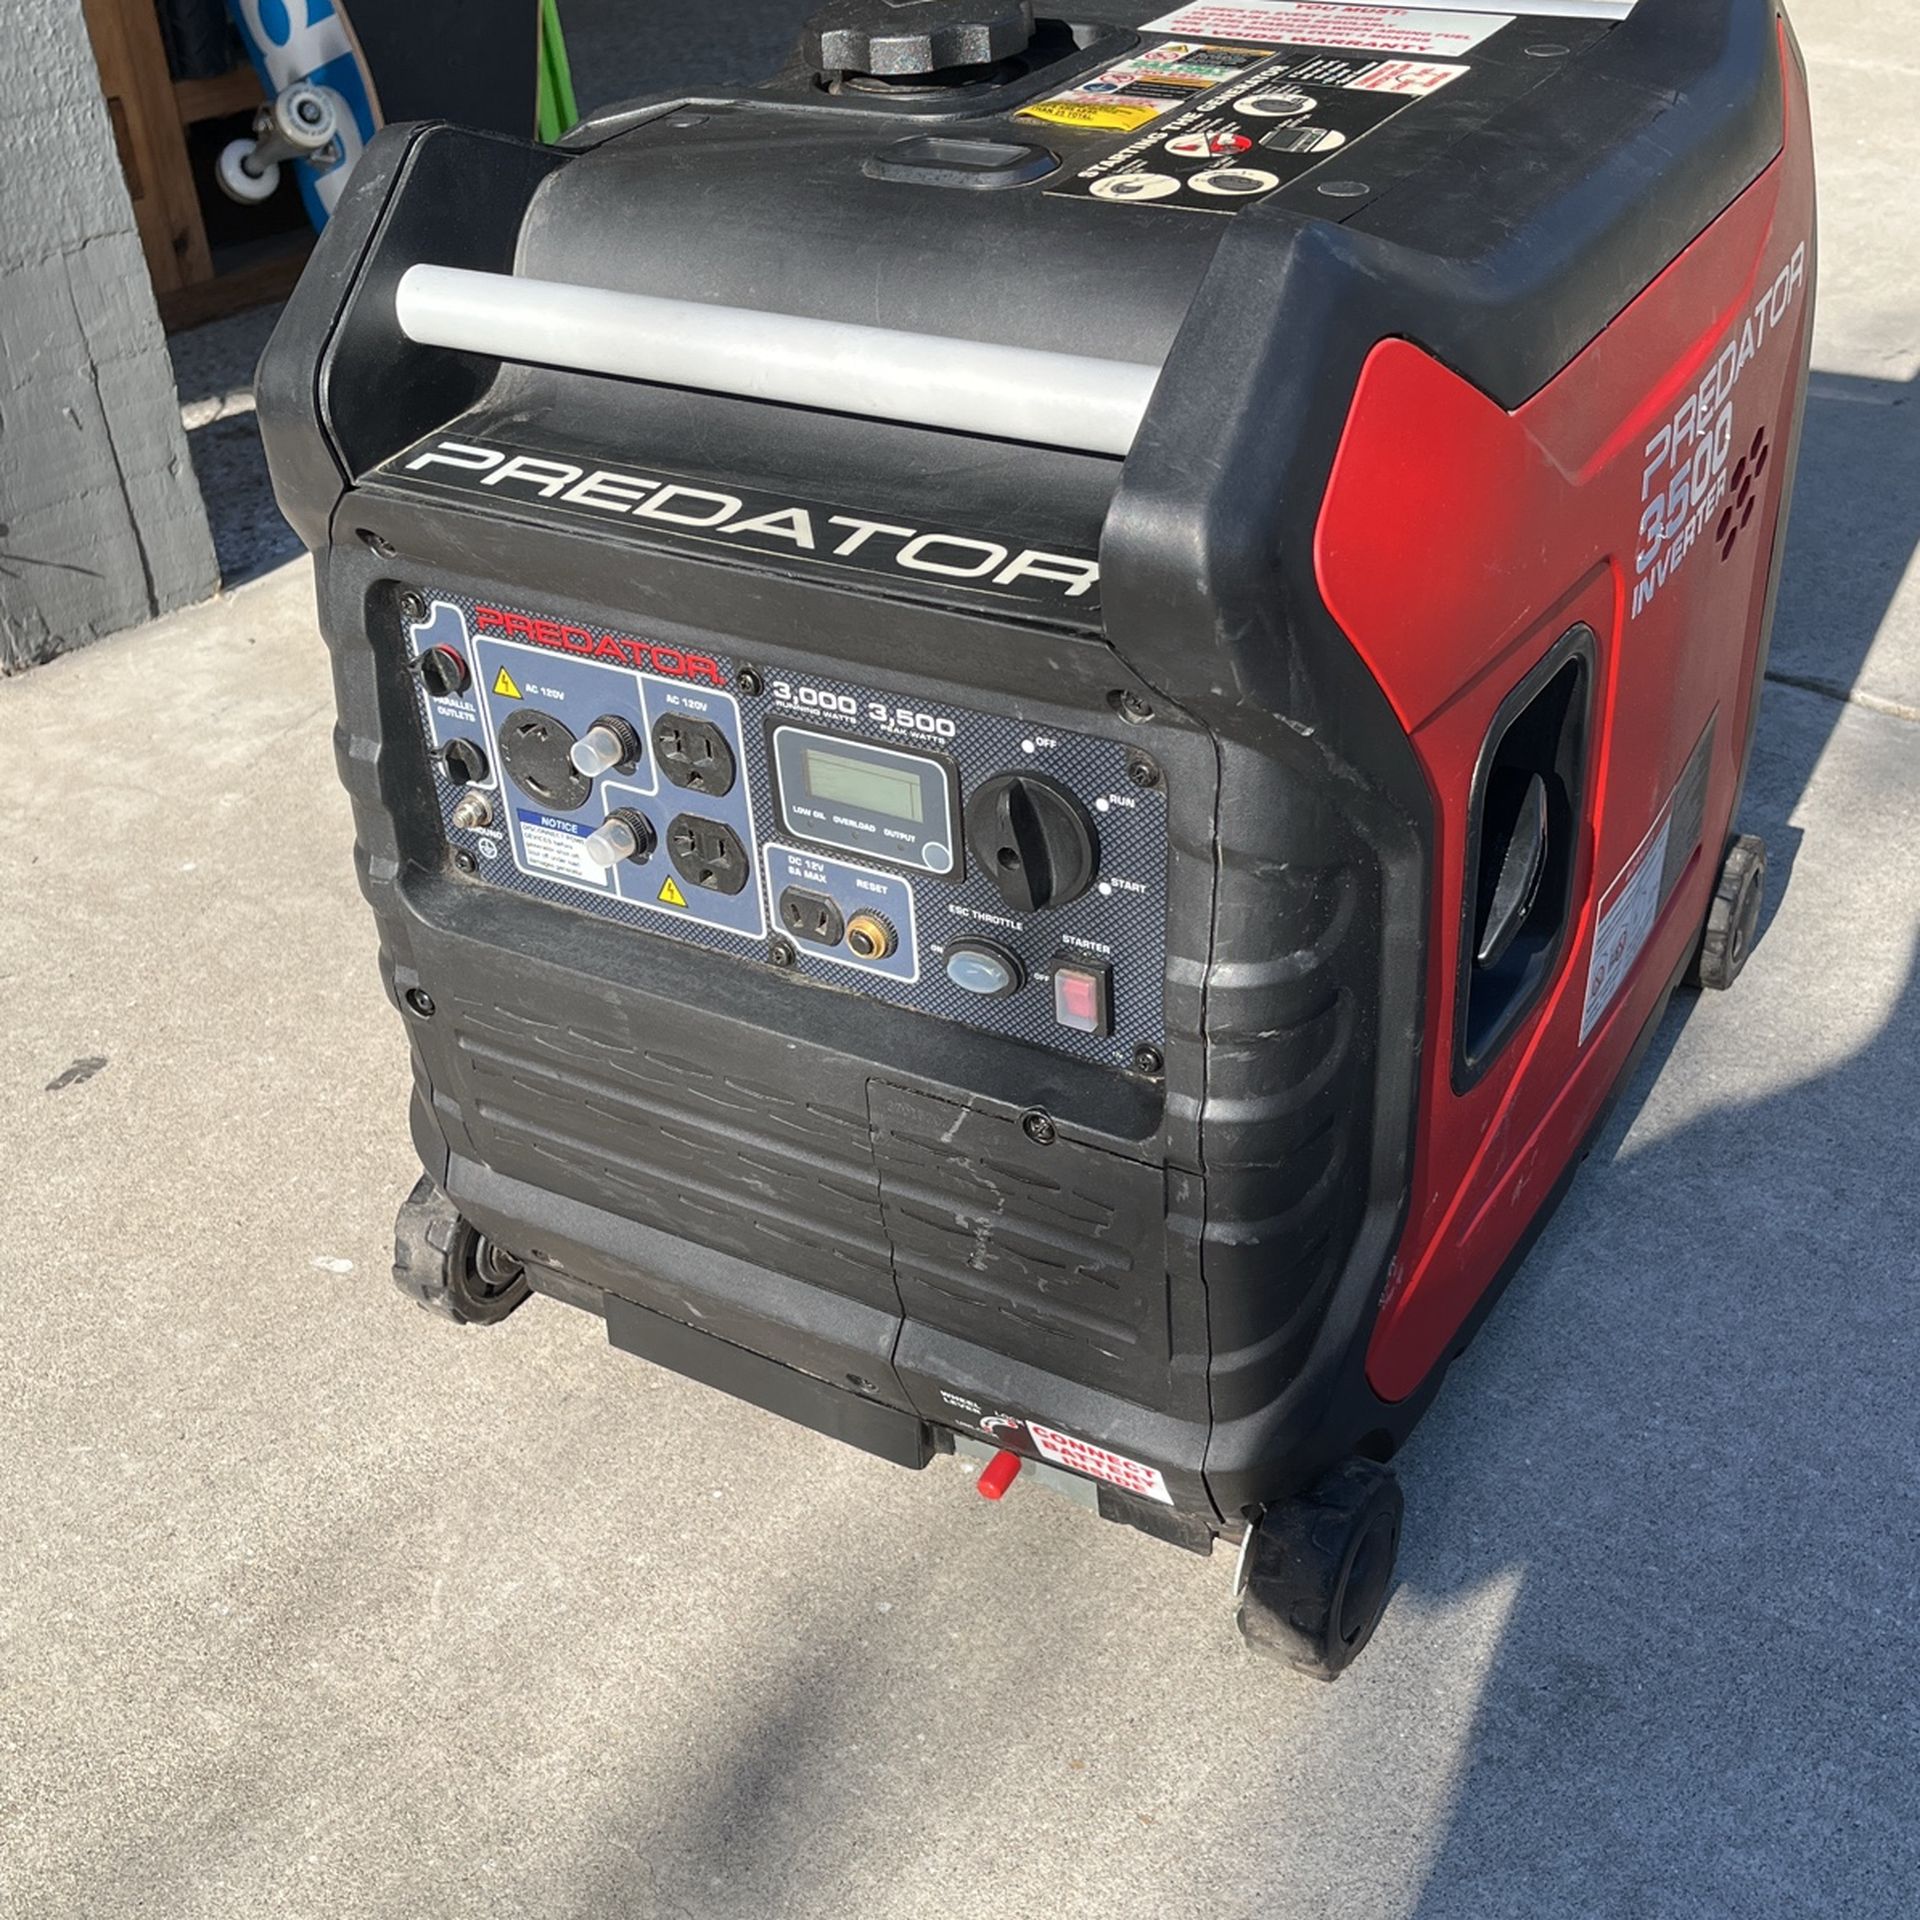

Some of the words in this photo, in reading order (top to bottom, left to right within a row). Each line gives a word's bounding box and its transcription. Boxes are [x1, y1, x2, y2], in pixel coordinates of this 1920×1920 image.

[1290, 36, 1435, 51] WARRANTY
[1077, 131, 1169, 179] STARTING
[1165, 112, 1205, 132] THE
[1196, 64, 1290, 112] GENERATOR
[1641, 241, 1806, 501] PREDATOR
[1635, 401, 1733, 575] 3500
[404, 441, 1101, 597] PREDATOR
[1631, 467, 1728, 621] INVERTER
[475, 605, 722, 685] PREDATOR
[525, 683, 538, 694] AC
[540, 687, 565, 700] 120V
[772, 680, 857, 715] 3,000
[666, 694, 680, 705] AC
[682, 698, 708, 712] 120V
[775, 700, 821, 716] RUNNING
[822, 711, 857, 724] WATTS
[437, 705, 476, 722] OUTLETS
[868, 702, 956, 738] 3,500
[880, 725, 907, 736] PEAK
[910, 731, 947, 745] WATTS
[1035, 736, 1057, 749] OFF
[1109, 794, 1135, 808] RUN
[792, 805, 812, 817] LOW
[812, 810, 826, 820] OIL
[467, 826, 503, 840] OUND
[541, 816, 578, 834] NOTICE
[832, 815, 876, 833] OVERLOAD
[883, 828, 916, 843] OUTPUT
[788, 855, 802, 866] DC
[805, 860, 825, 872] 12V
[804, 869, 827, 884] MAX
[1110, 877, 1147, 894] START
[856, 879, 888, 895] RESET
[949, 904, 970, 917] ESC
[971, 909, 1024, 931] THROTTLE
[1062, 934, 1111, 954] STARTER
[1033, 972, 1049, 982] OFF
[1032, 1425, 1158, 1479] CONNECT
[1041, 1439, 1156, 1489] BATTERY
[1062, 1455, 1150, 1494] INSIDE
